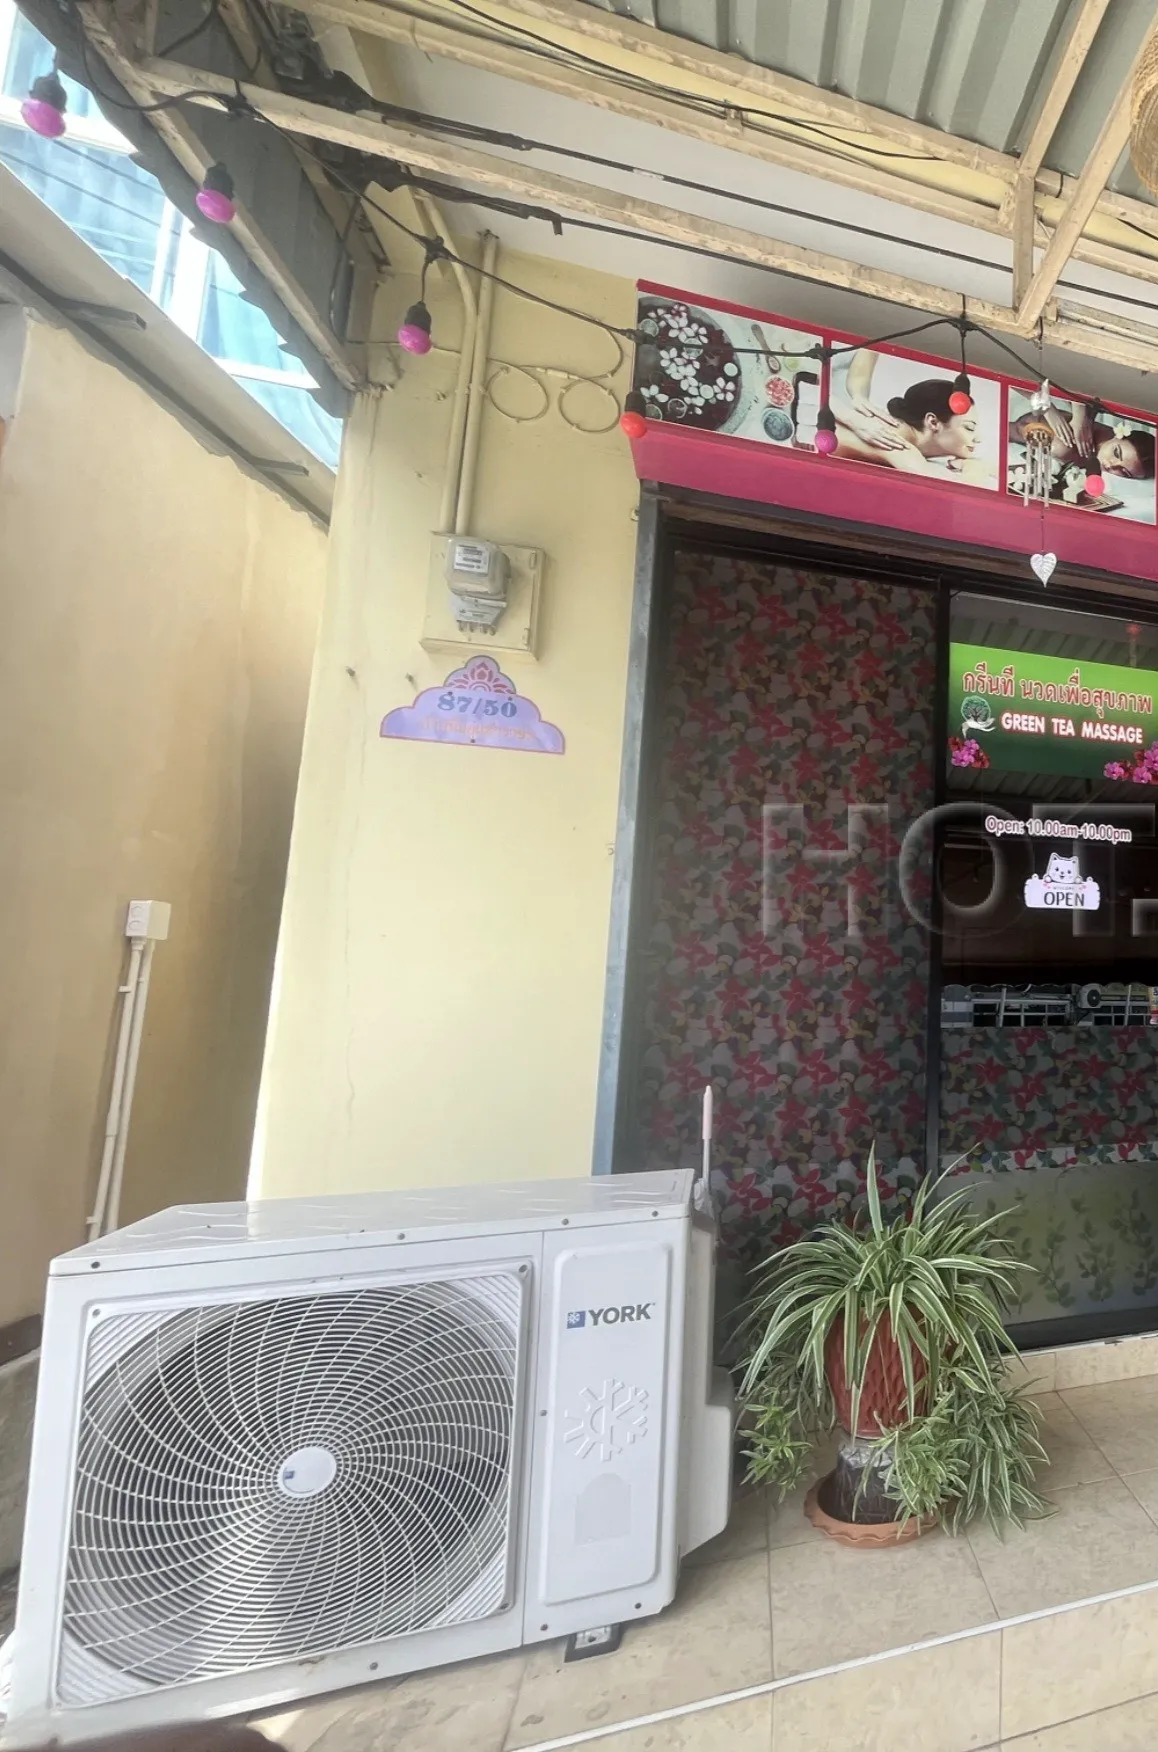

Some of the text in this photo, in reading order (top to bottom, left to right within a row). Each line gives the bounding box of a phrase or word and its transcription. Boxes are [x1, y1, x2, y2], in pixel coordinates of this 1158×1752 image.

[963, 662, 1153, 718] กรีนที นวดเพื่อสุขภาพ
[437, 694, 517, 718] 87/50
[1001, 712, 1143, 744] GREEN TEA MASSAGE
[985, 815, 1133, 845] Open: 10.00am-10.00pm
[1043, 891, 1085, 907] OPEN
[588, 1302, 652, 1326] YORK
